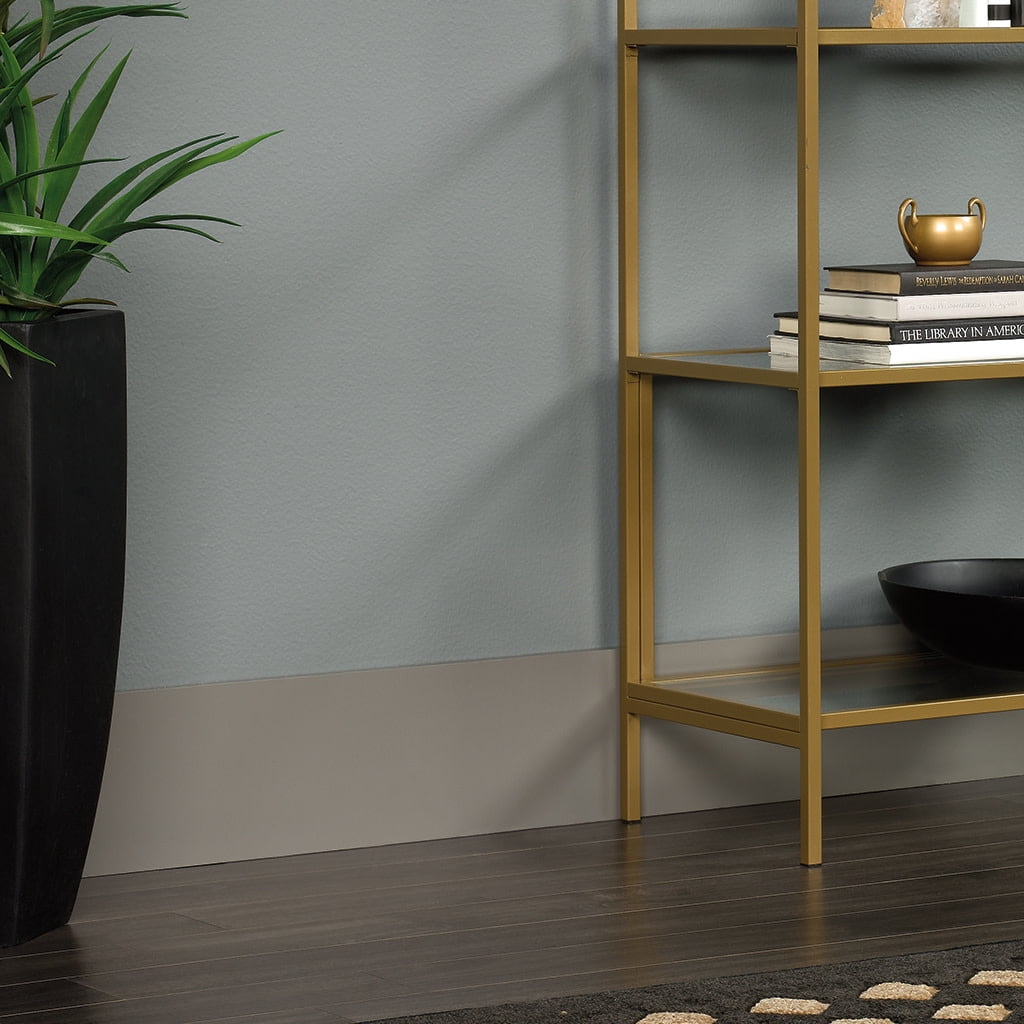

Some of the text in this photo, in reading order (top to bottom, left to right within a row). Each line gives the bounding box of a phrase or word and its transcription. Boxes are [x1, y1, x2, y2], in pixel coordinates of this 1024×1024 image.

[900, 329, 922, 341] THE
[924, 326, 969, 340] LIBRARY
[971, 325, 983, 337] IN
